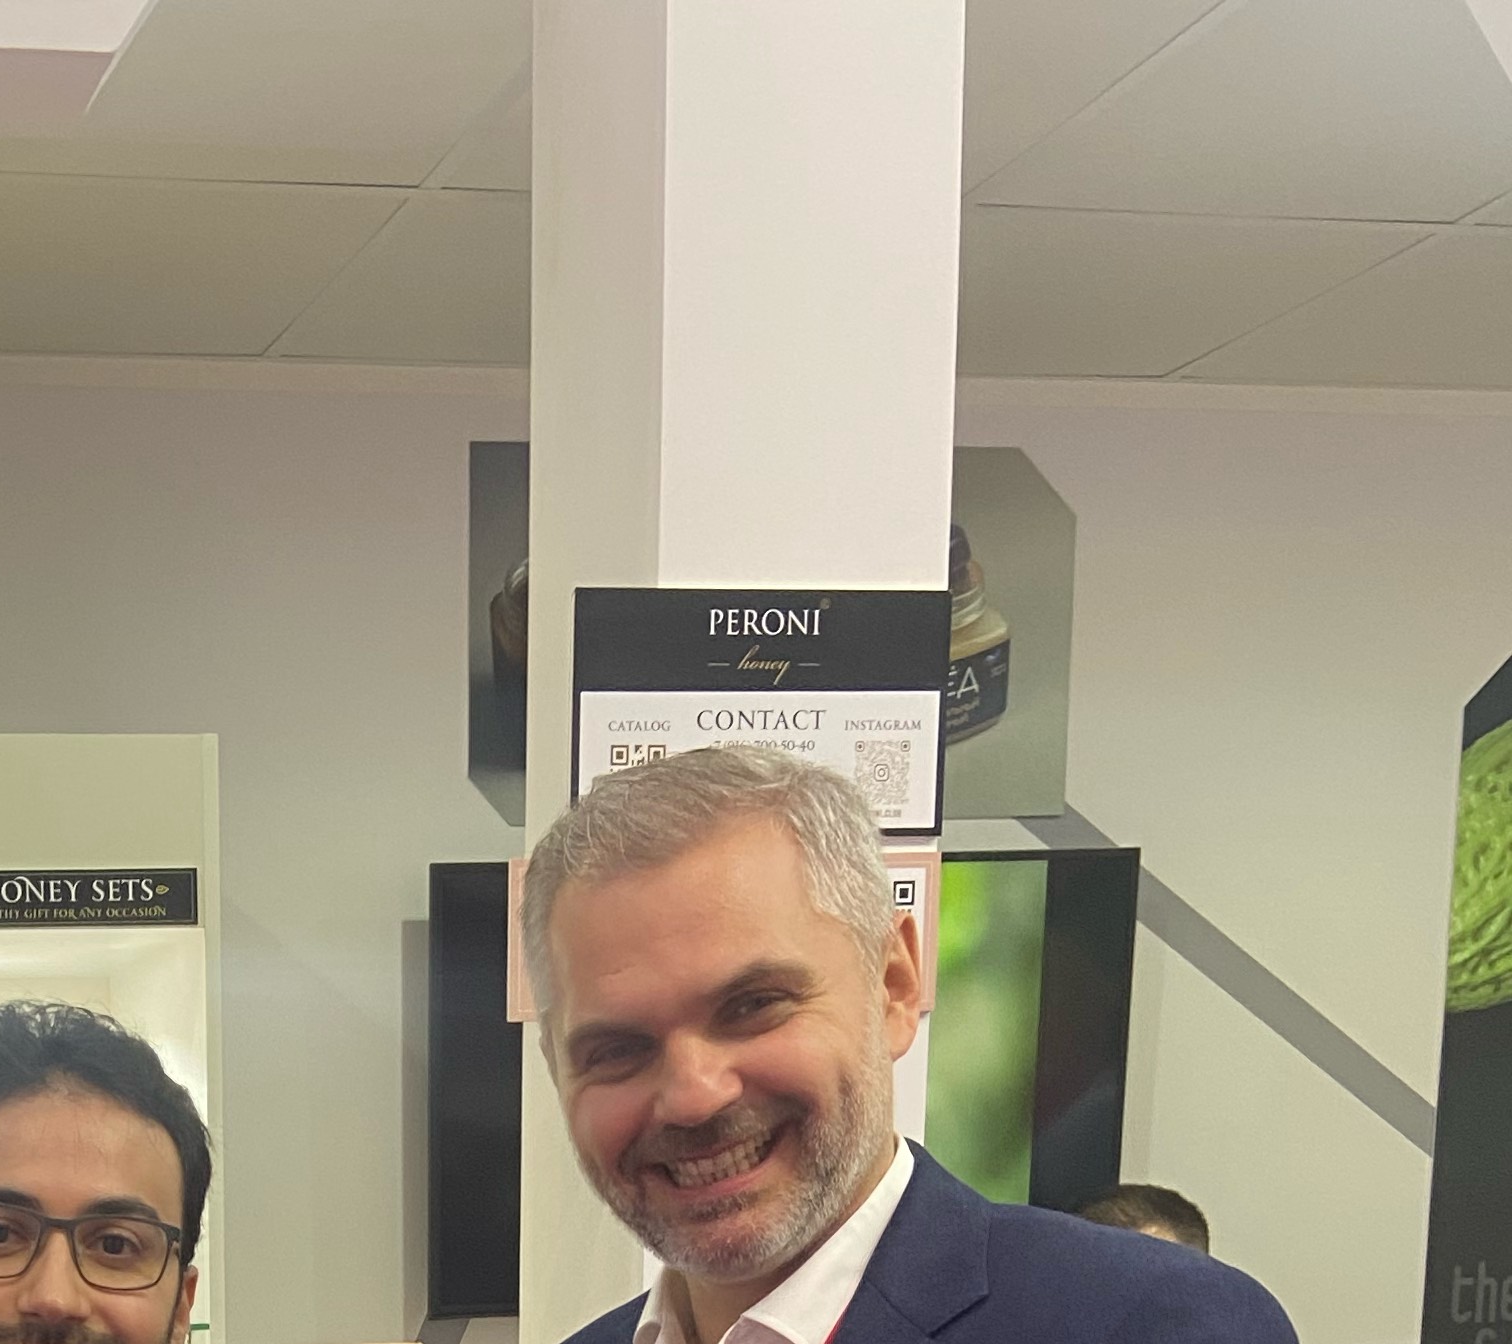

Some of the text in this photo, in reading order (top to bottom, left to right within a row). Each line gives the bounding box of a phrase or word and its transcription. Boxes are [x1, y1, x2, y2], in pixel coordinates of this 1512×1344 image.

[708, 607, 822, 637] PERONI
[737, 643, 792, 687] honey
[608, 719, 672, 733] CATALOG
[696, 708, 827, 732] CONTACT
[844, 718, 923, 732] INSTAGRAM
[91, 877, 155, 902] SETS
[24, 908, 50, 920] GIFT
[53, 908, 79, 920] FOR
[79, 906, 103, 919] ANY
[105, 904, 168, 918] OCCASION
